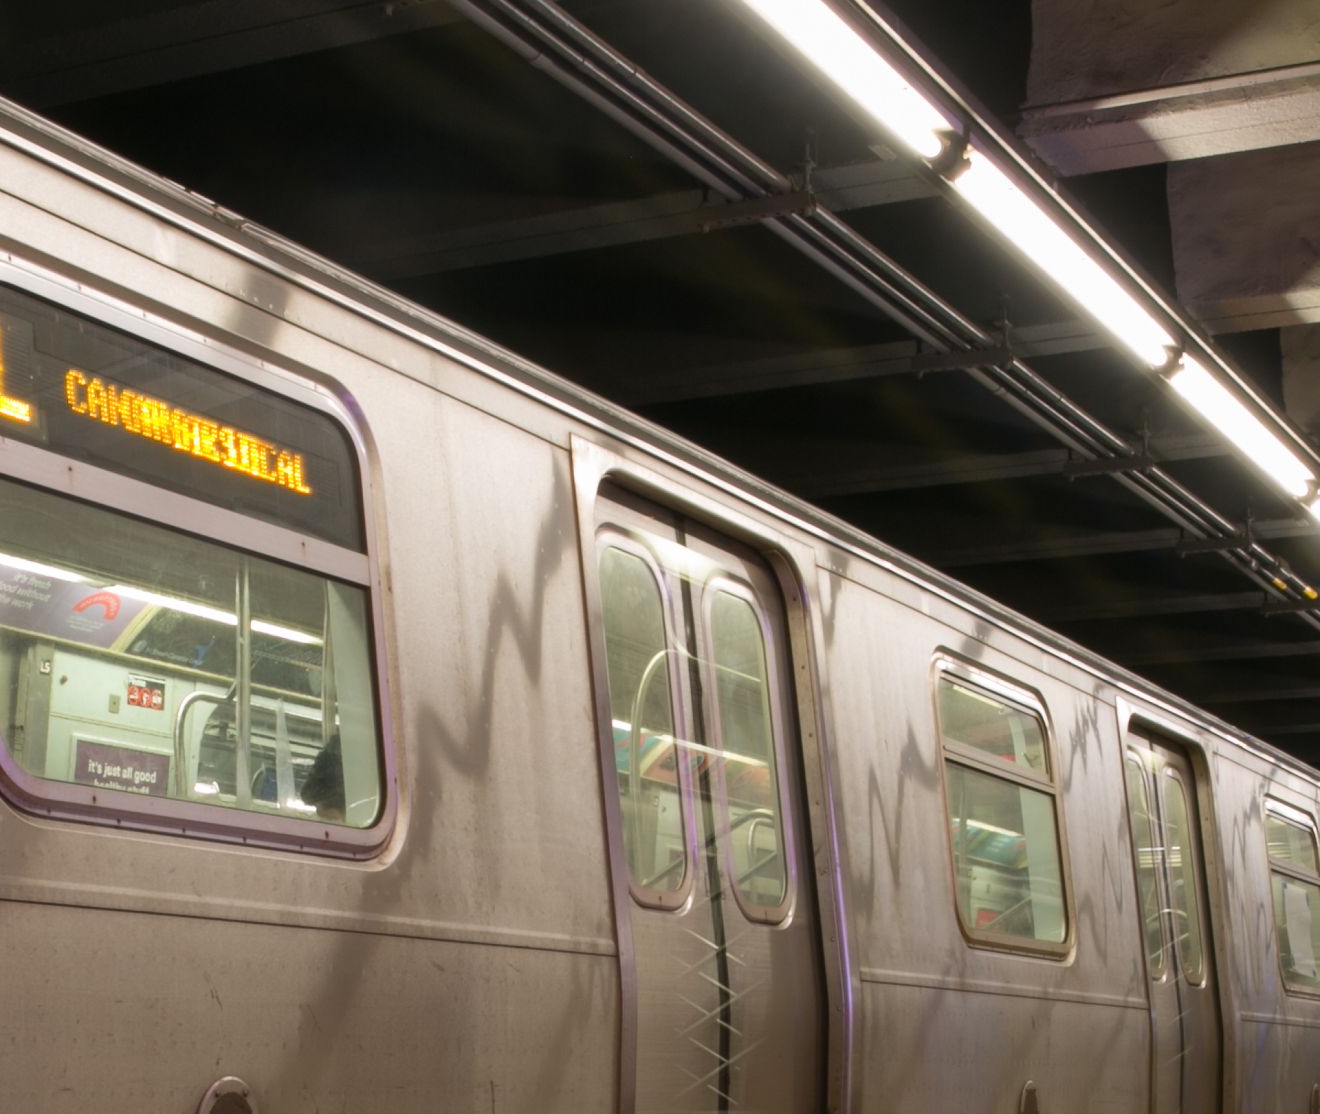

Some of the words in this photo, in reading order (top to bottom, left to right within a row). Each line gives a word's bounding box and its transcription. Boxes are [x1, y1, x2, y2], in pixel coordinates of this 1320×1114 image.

[88, 759, 102, 774] it's
[103, 762, 121, 778] just
[122, 767, 133, 779] all
[134, 771, 157, 784] good
